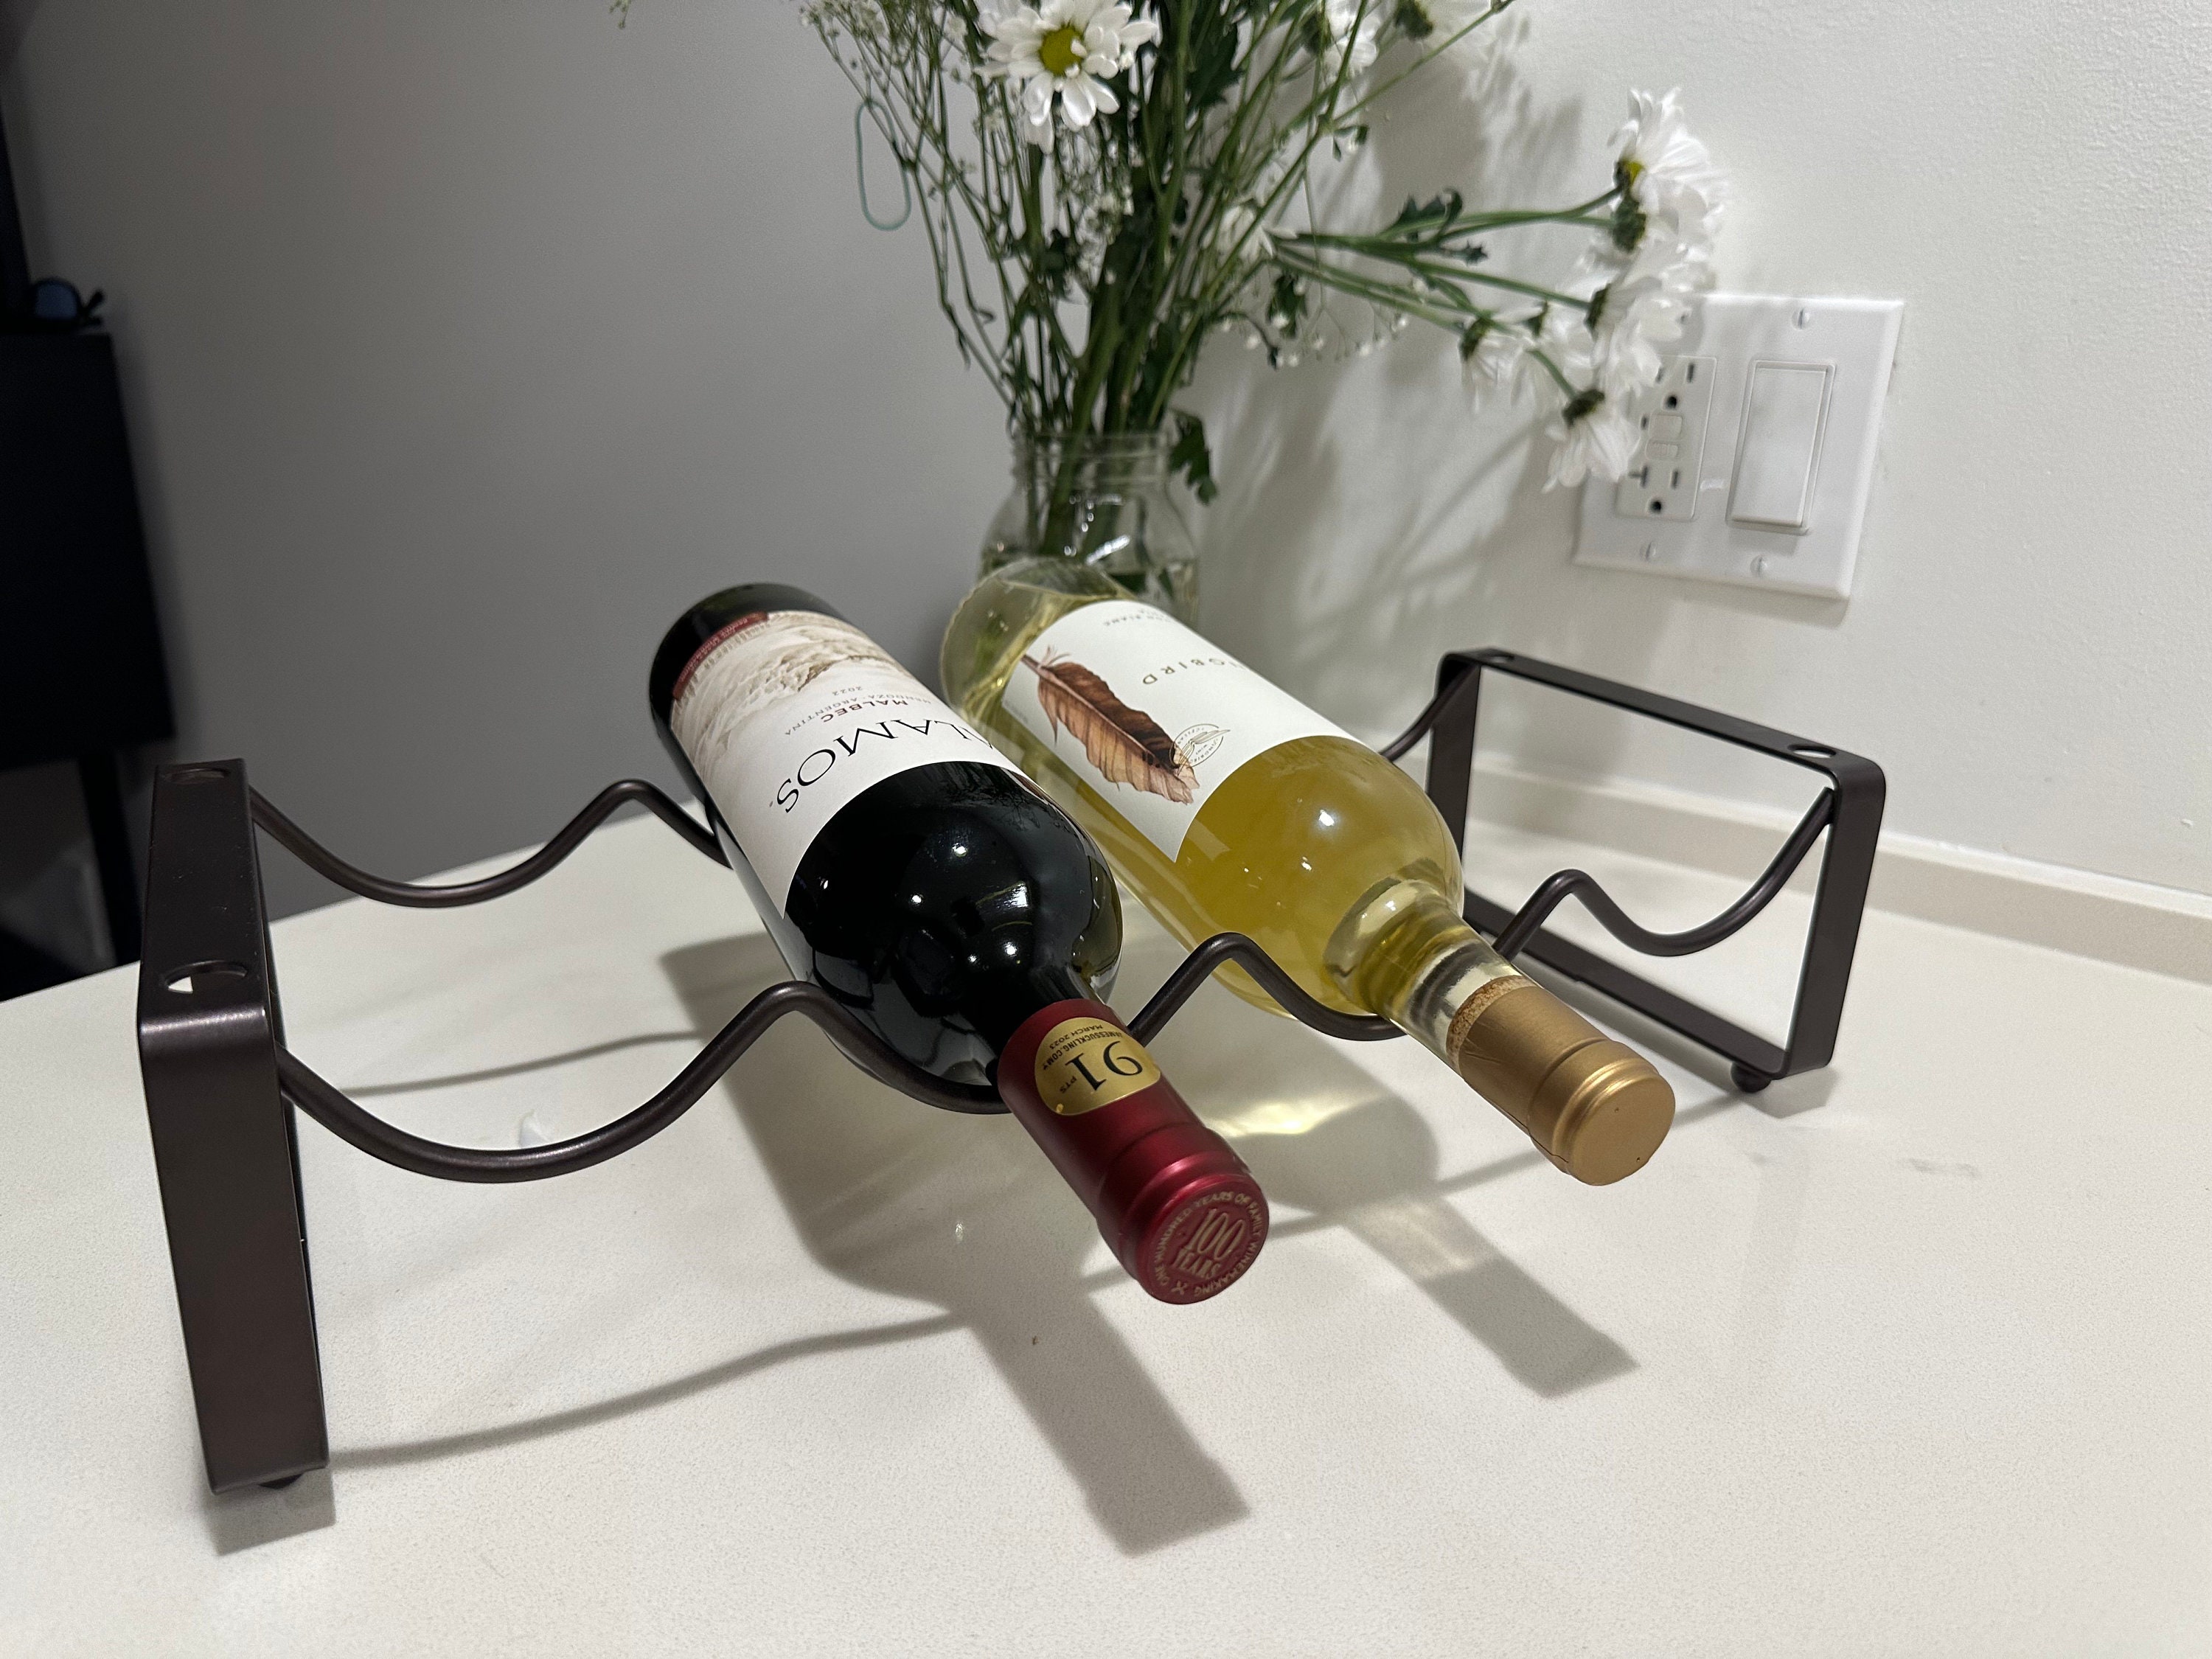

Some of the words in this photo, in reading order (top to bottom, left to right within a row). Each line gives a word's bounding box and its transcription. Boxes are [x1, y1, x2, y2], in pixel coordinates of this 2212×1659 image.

[832, 686, 863, 696] 2022
[785, 697, 858, 736] ARGENTINA
[820, 699, 908, 723] MALBEC
[1049, 1034, 1071, 1050] 2023
[1071, 1024, 1104, 1037] MARCH
[1047, 1031, 1123, 1066] JAMESSUCKLING.COM
[1065, 1040, 1143, 1091] 91
[1059, 1076, 1077, 1093] PTS
[1194, 1191, 1235, 1208] YEARS
[1234, 1193, 1252, 1205] OF
[1246, 1202, 1264, 1238] FAMILY
[1185, 1208, 1245, 1261] 100
[1155, 1264, 1171, 1287] ONE
[1171, 1248, 1222, 1280] YEARS
[1193, 1240, 1259, 1298] WINEMAKING
